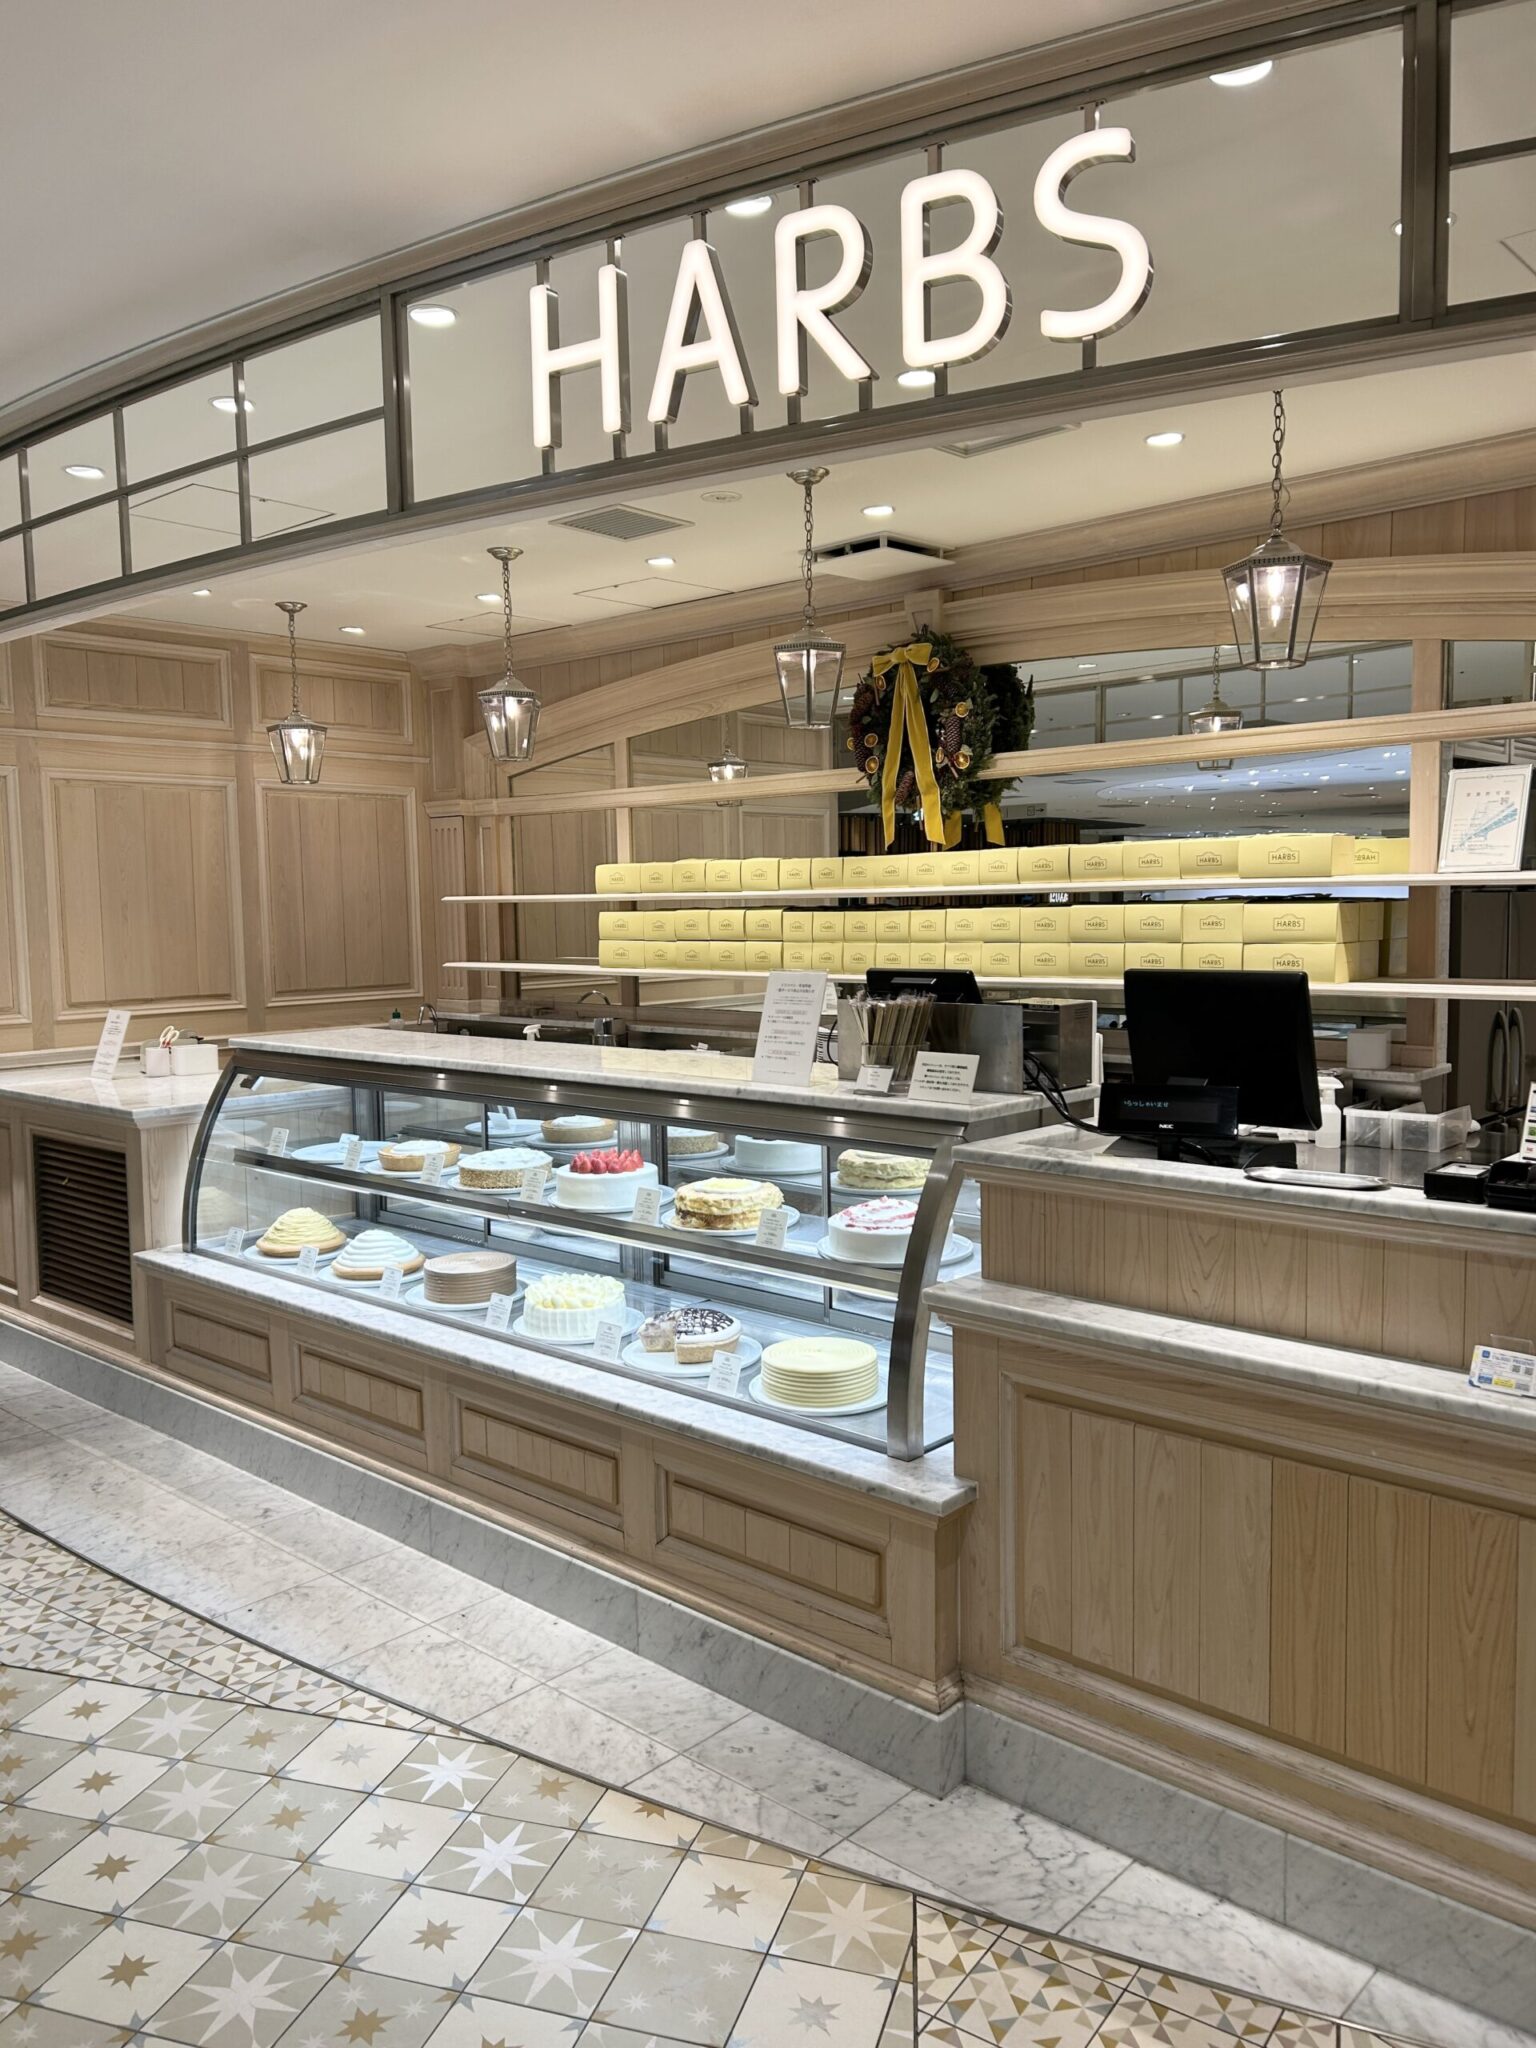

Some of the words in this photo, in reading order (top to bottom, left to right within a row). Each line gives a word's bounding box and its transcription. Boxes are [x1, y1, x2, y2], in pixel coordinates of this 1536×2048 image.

[529, 126, 1153, 449] HARBS
[1276, 921, 1301, 929] HARBS
[1276, 960, 1300, 968] HARBS
